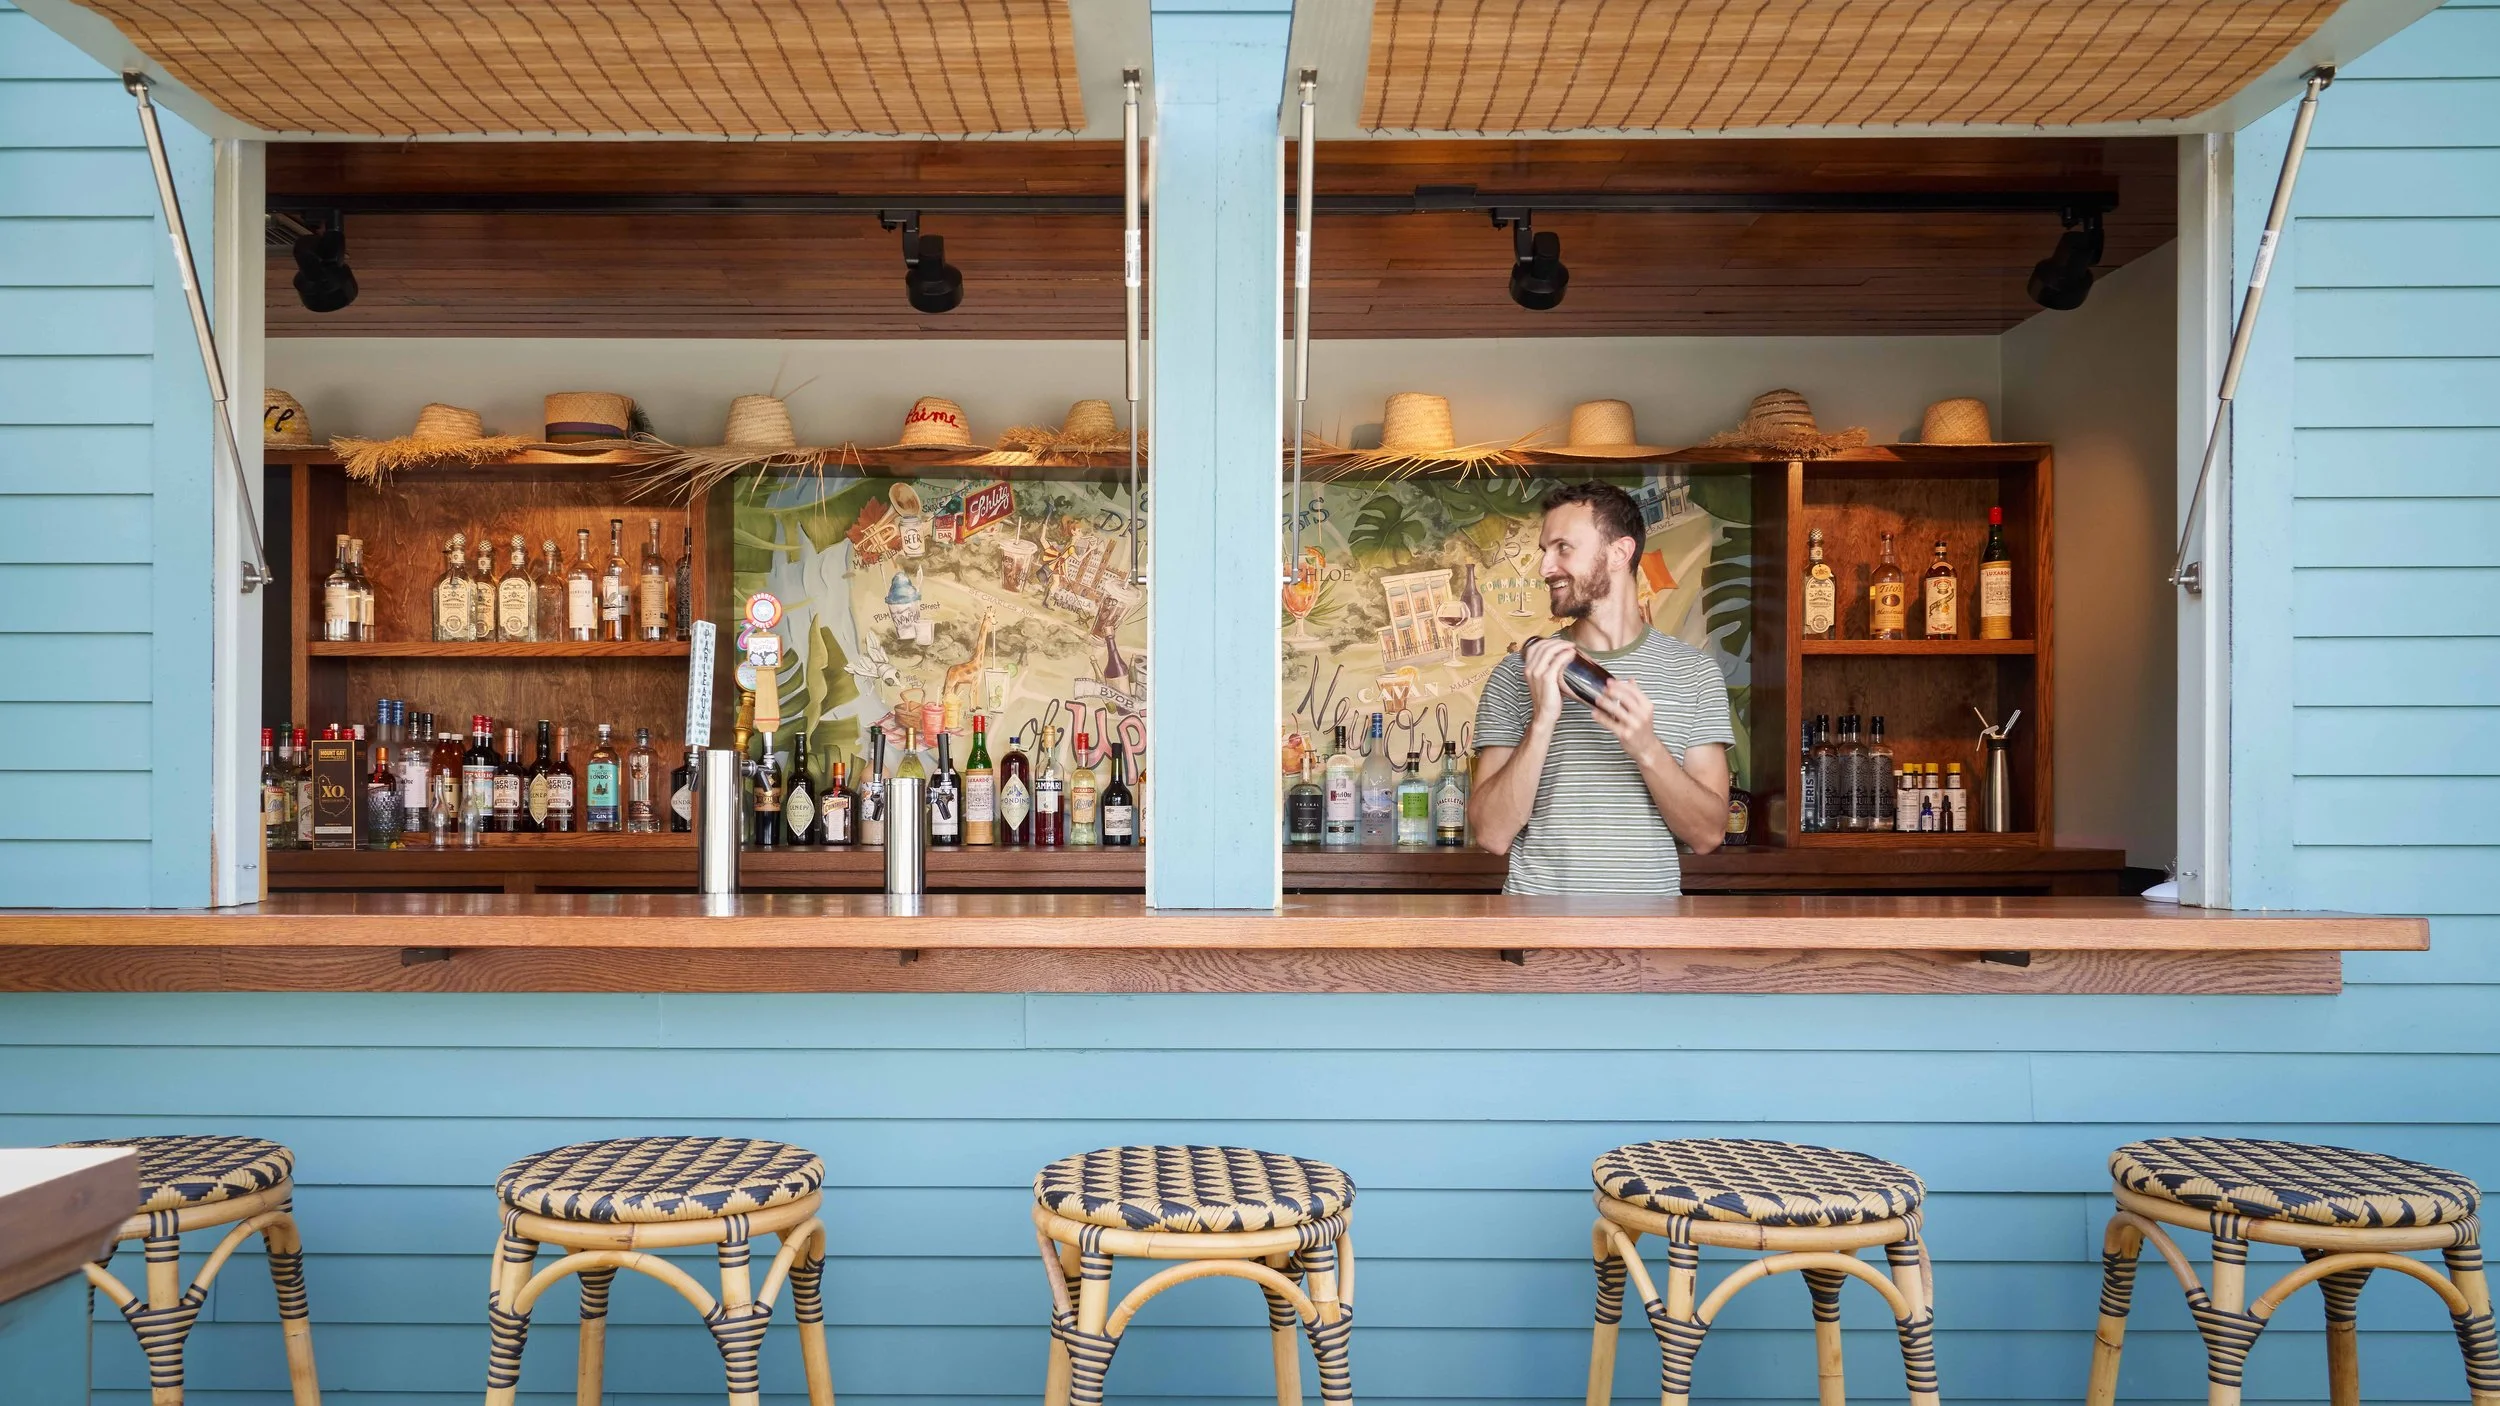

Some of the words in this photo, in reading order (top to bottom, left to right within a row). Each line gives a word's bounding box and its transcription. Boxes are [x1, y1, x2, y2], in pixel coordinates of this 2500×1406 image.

[969, 484, 1010, 527] Schlitz
[903, 532, 923, 545] BEER
[938, 532, 953, 541] BAR
[1297, 568, 1353, 582] HLOE
[1497, 591, 1533, 605] PALAE
[1100, 686, 1135, 709] BYOB
[1357, 681, 1440, 704] CAVAN
[321, 784, 346, 798] XO
